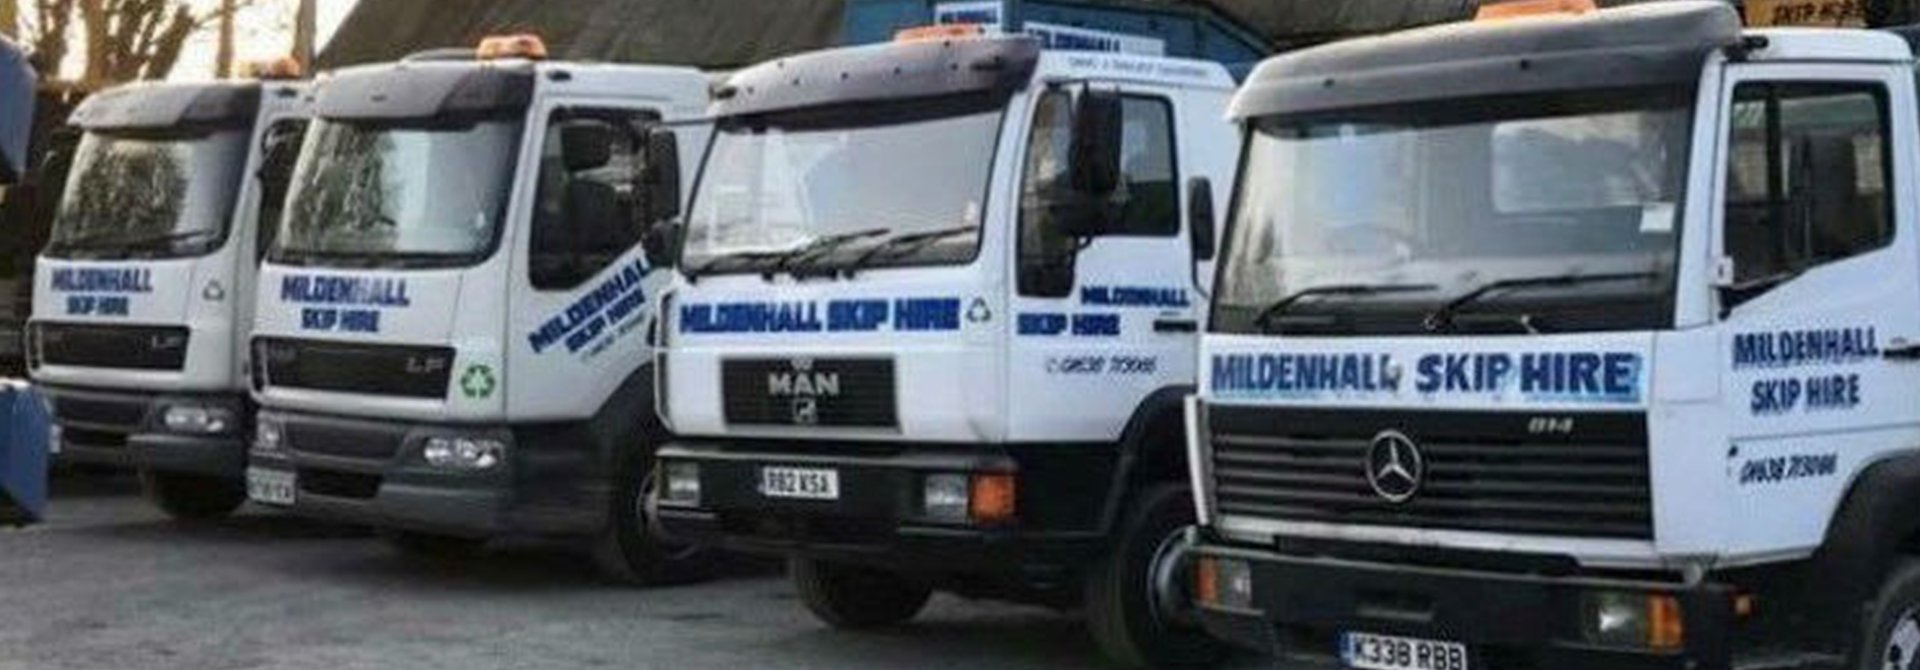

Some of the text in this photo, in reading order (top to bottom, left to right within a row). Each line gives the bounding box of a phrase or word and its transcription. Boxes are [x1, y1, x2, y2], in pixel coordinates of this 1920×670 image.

[51, 267, 153, 292] MILDENHALL
[281, 275, 410, 307] MILDENHALL
[1081, 286, 1191, 308] MILDENHALL
[302, 308, 380, 332] SKIP HIRE
[680, 298, 961, 332] MILDENHALL SKIP HIRE
[1017, 313, 1121, 336] SKIP HIRE
[1732, 325, 1880, 369] MILDENHALL
[768, 372, 840, 395] MAN
[1211, 352, 1637, 394] MILDENHALL SKIP HIRE
[1750, 372, 1862, 416] SKIP HIRE
